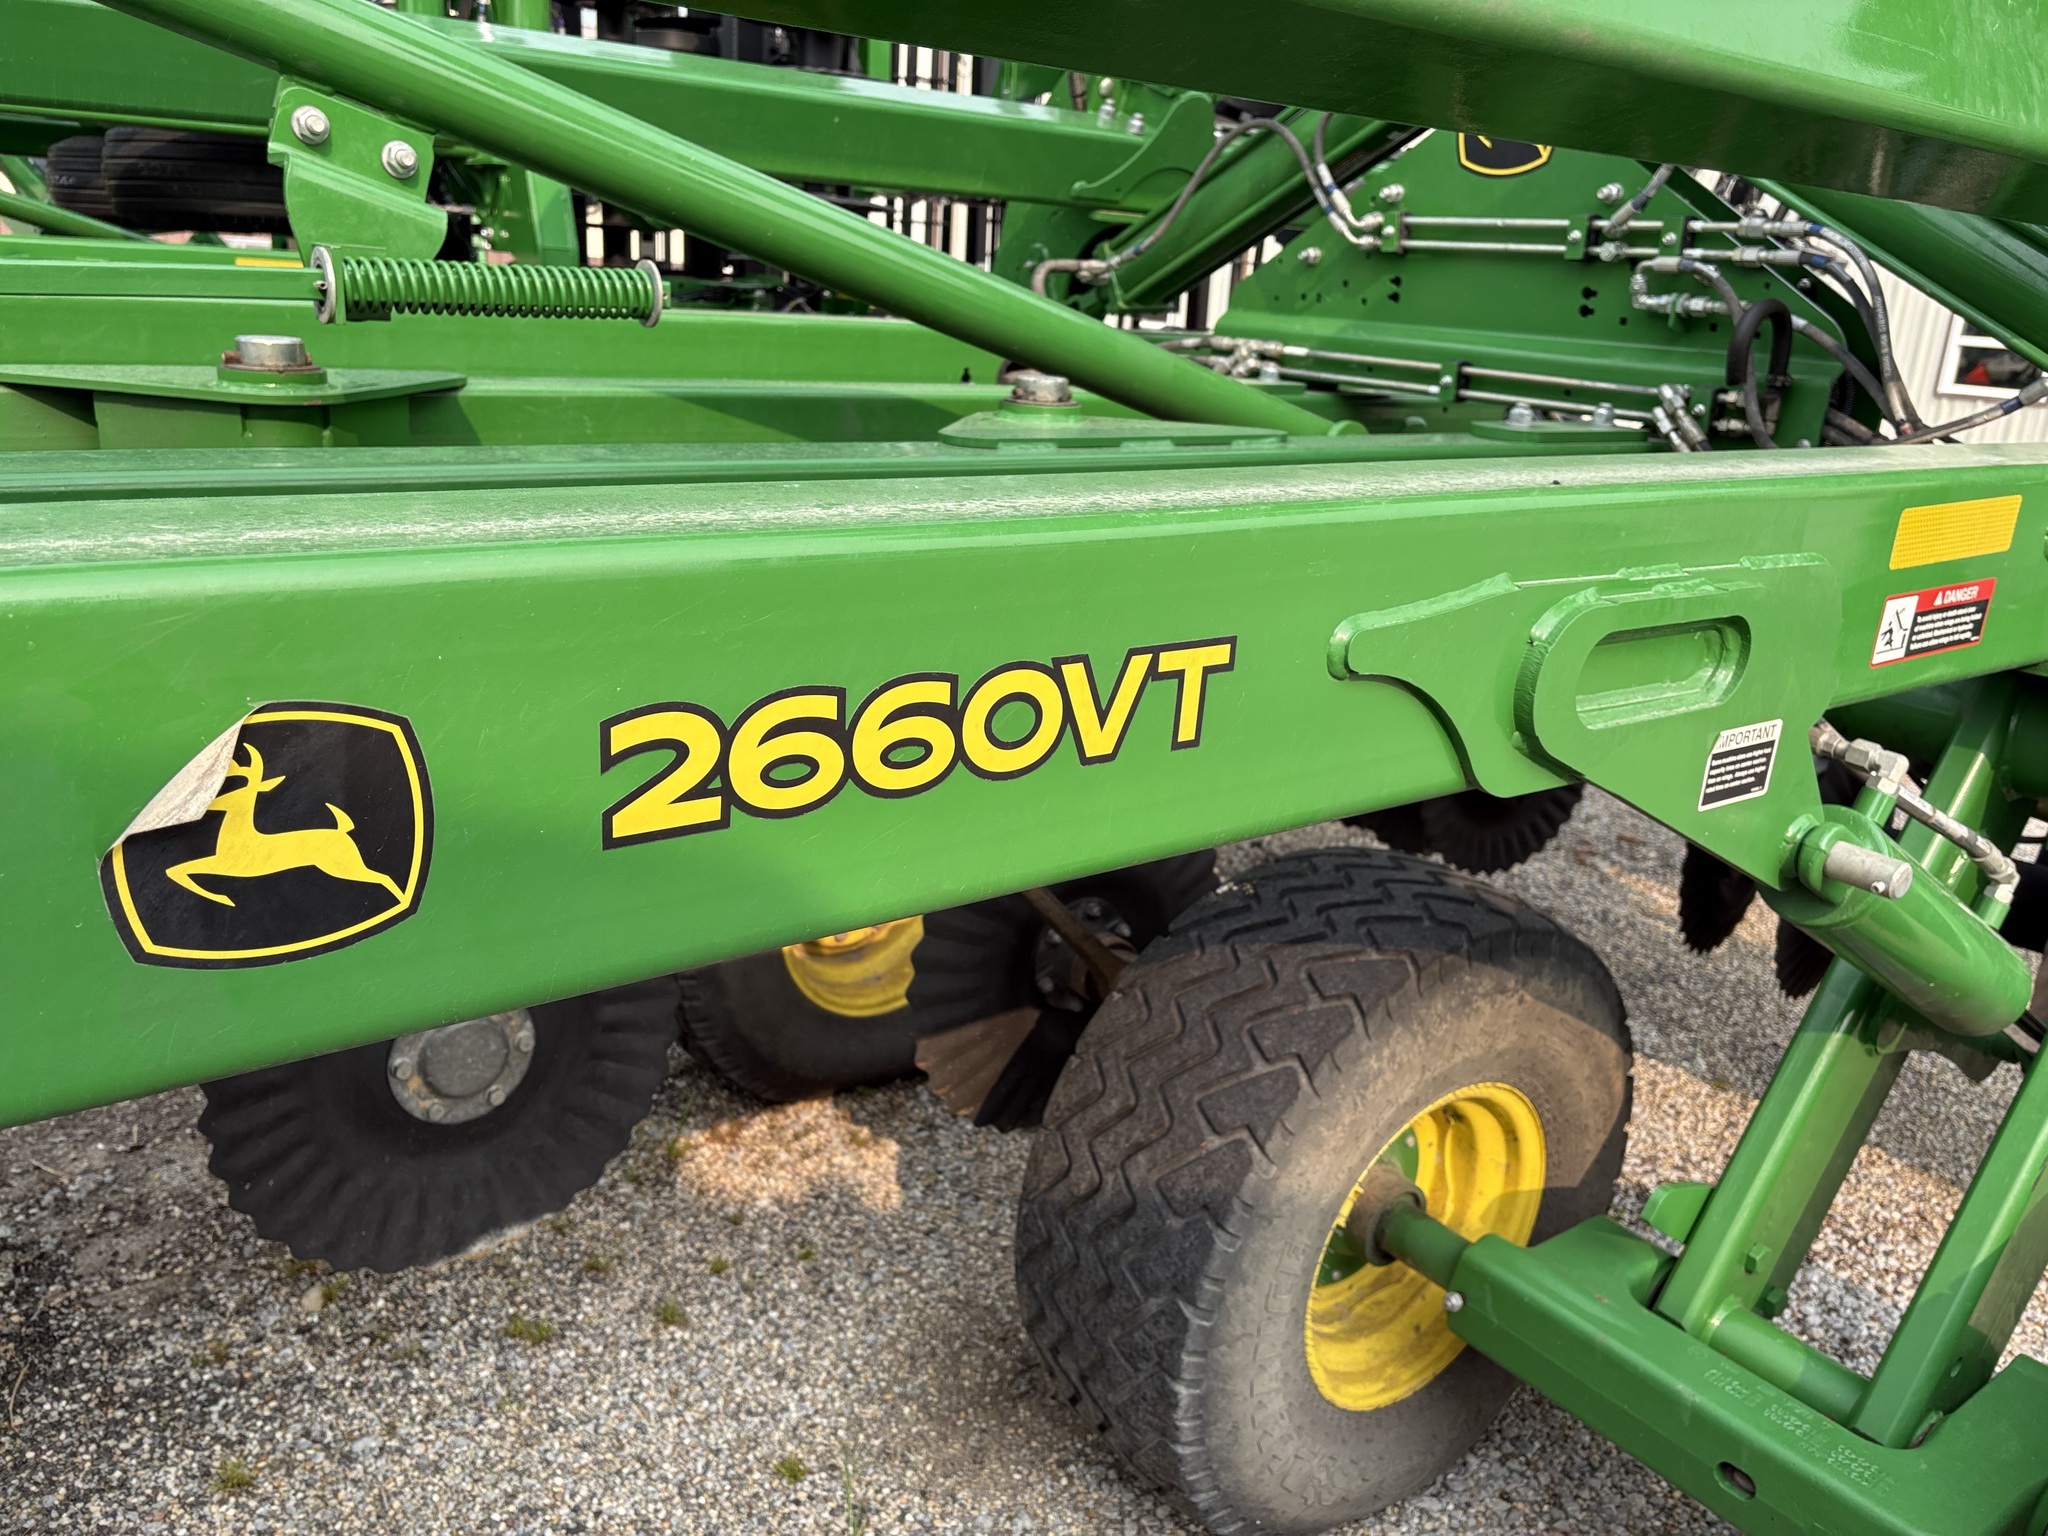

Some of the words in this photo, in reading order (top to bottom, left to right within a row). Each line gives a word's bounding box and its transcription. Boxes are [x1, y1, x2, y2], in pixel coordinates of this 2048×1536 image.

[1943, 586, 1979, 604] DANGER
[600, 635, 1238, 850] 2660VT
[1716, 724, 1777, 749] MPORTANT
